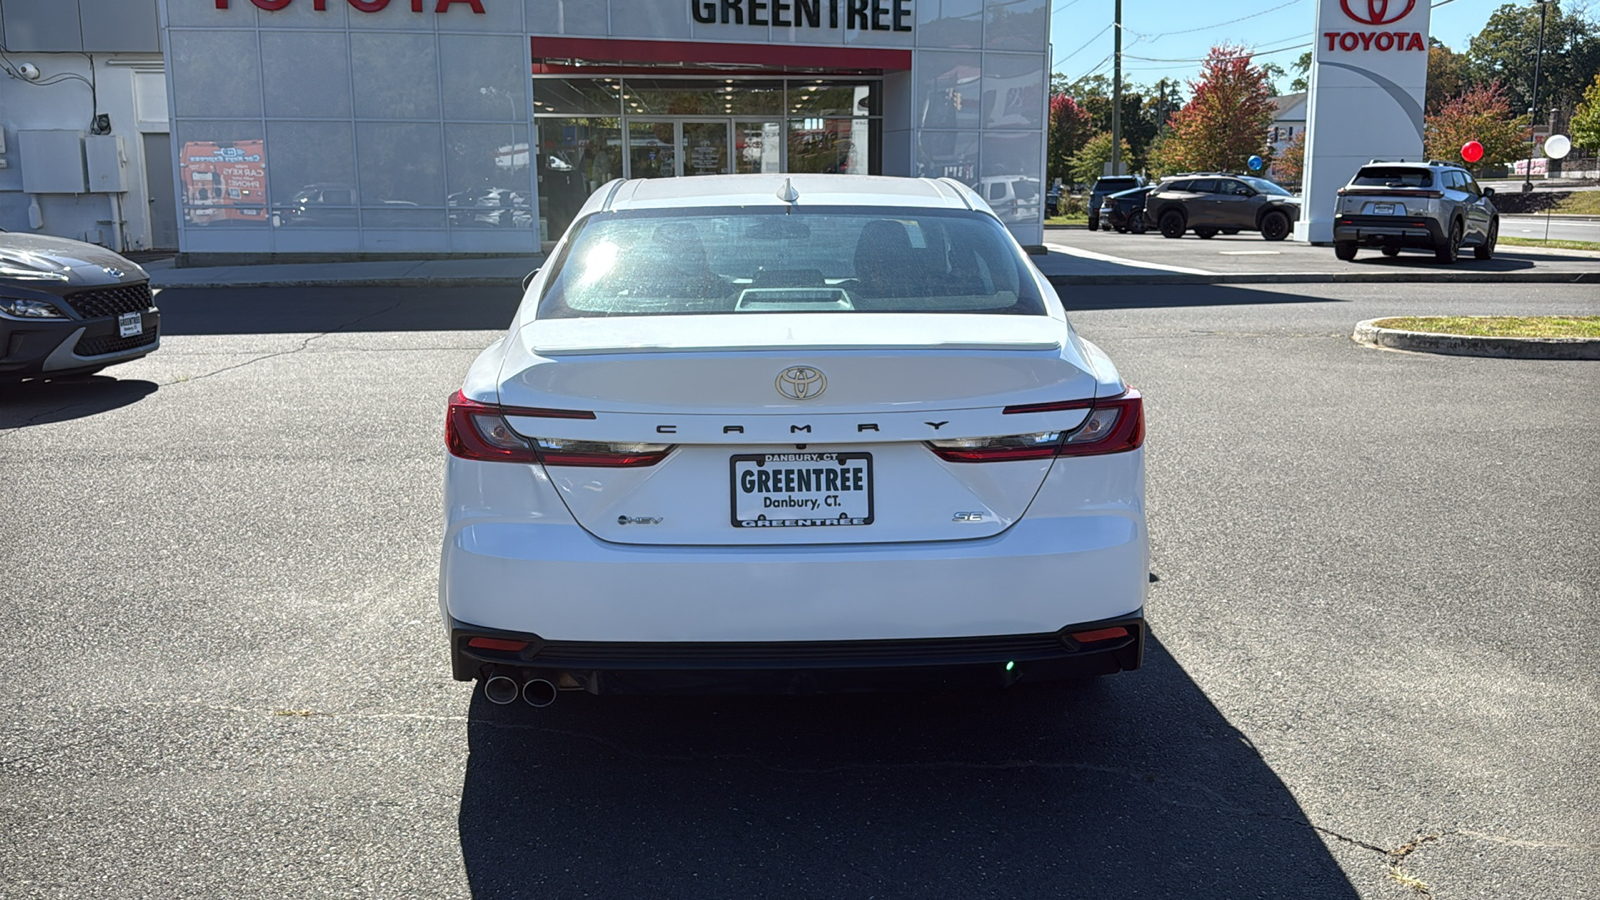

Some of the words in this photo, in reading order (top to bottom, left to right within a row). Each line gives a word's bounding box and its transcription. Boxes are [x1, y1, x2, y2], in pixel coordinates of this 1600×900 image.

[1323, 31, 1425, 52] TOYOTA
[656, 421, 949, 434] CAMRY
[765, 454, 820, 462] DANBURY,
[823, 453, 838, 461] CT
[741, 467, 863, 493] GREENTREE
[764, 495, 820, 510] Danbury,
[824, 495, 841, 507] CT.
[741, 518, 865, 527] GREENTREE
[952, 511, 984, 521] SE
